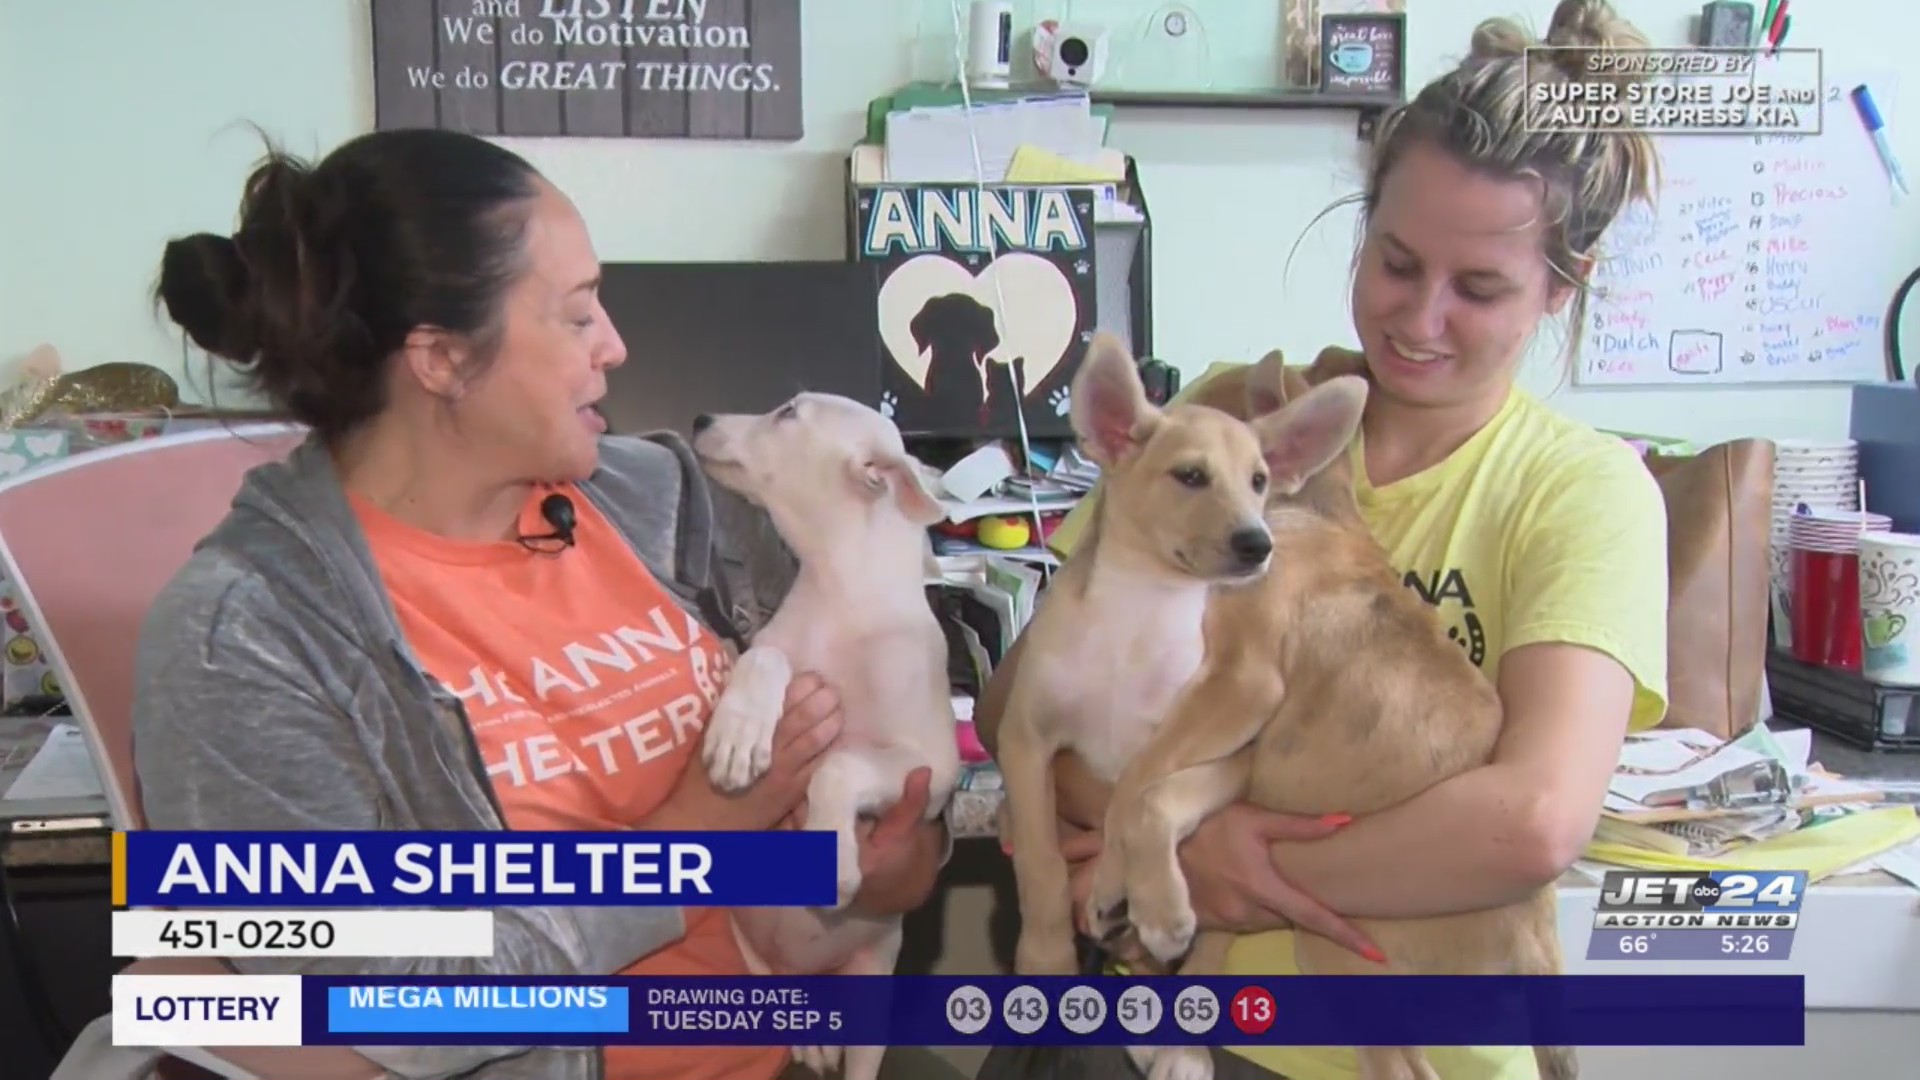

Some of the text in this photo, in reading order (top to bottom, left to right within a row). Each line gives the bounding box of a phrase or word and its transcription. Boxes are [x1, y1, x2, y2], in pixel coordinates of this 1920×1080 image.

[472, 0, 706, 20] and LISTEN
[444, 17, 751, 48] We do Motivation
[407, 62, 781, 92] We do GREAT THINGS.
[865, 187, 1088, 254] ANNA
[1603, 325, 1660, 354] Dutch
